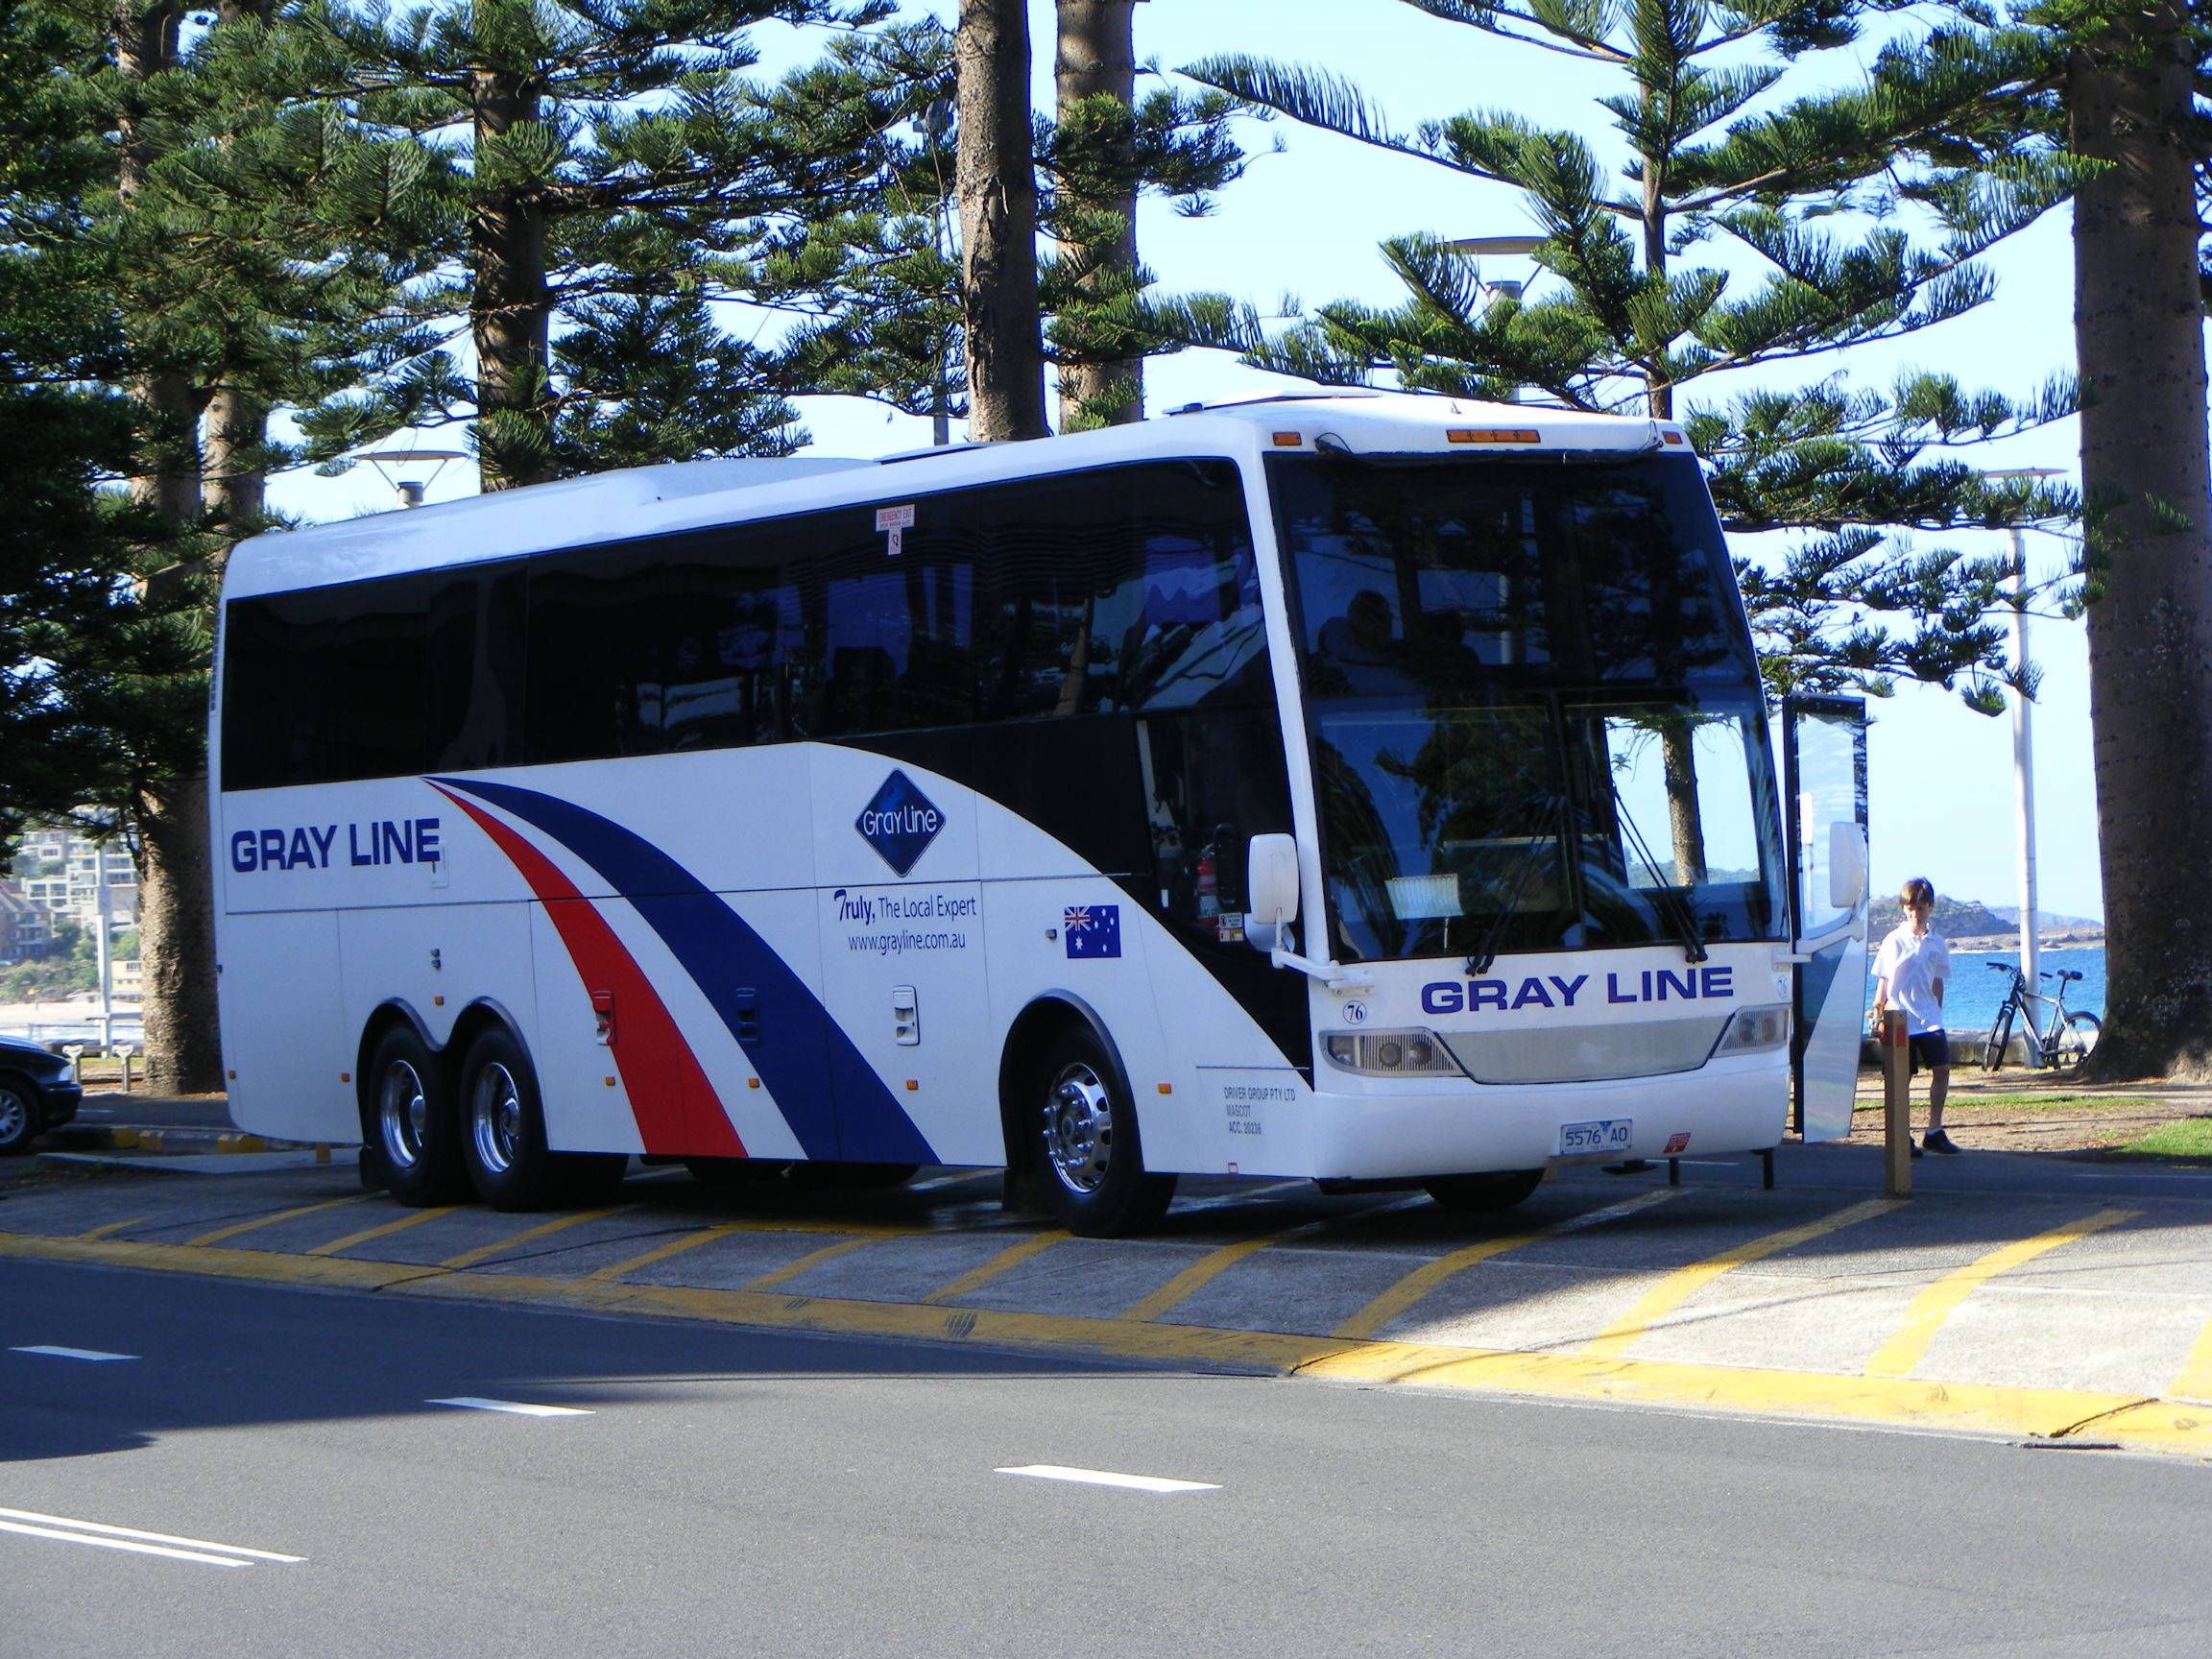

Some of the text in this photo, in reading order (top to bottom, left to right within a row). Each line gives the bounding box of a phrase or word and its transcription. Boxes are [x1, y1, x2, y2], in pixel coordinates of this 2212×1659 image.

[862, 809, 902, 836] Gray
[231, 818, 441, 873] GRAY LINE
[833, 889, 976, 926] Truly, The Local Expert
[848, 929, 966, 955] www.grayline.com.au
[1421, 966, 1734, 1015] GRAY LINE
[1347, 1004, 1363, 1022] 76
[1223, 1086, 1296, 1101] DRIVER GROUP PTY LTD
[1226, 1104, 1251, 1118] MASCOT
[1566, 1129, 1601, 1146] 5576
